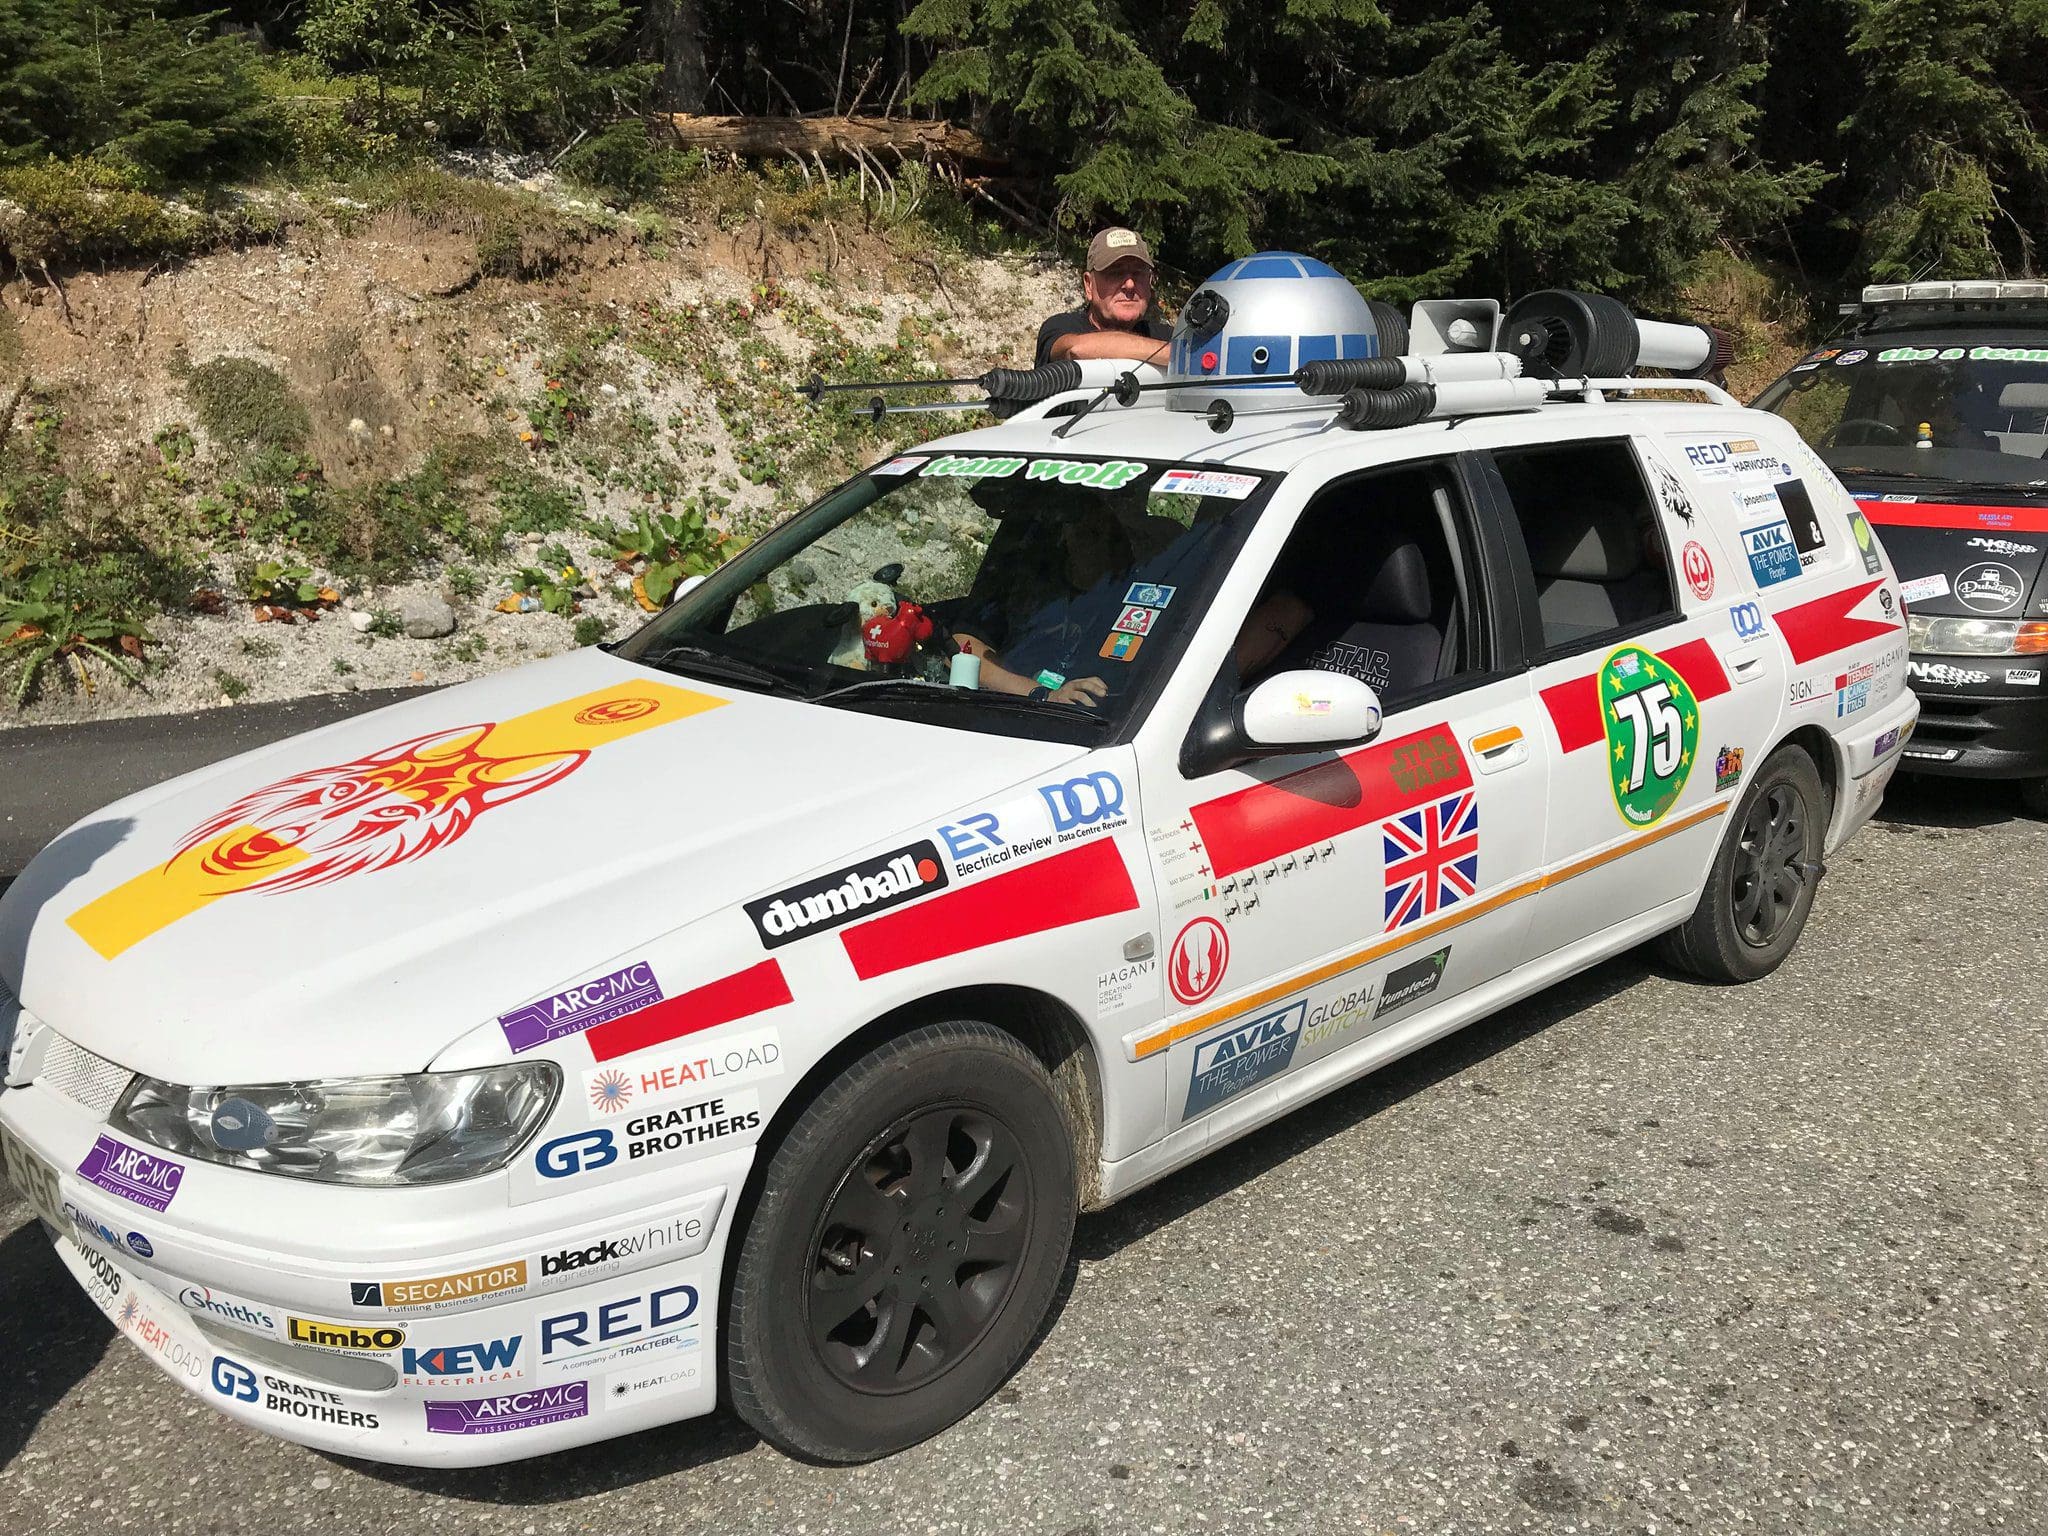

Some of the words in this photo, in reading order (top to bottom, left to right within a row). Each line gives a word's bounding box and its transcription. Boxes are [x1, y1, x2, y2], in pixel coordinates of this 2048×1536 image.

[1878, 347, 1939, 362] the
[1939, 348, 1965, 359] a
[918, 455, 1027, 477] team
[1025, 458, 1148, 489] wolf
[1685, 445, 1726, 466] RED
[1732, 457, 1779, 472] HARWOODS
[1752, 528, 1785, 551] AVK
[1810, 521, 1822, 543] &
[1753, 553, 1770, 570] THE
[1768, 545, 1795, 566] POWER
[1313, 641, 1390, 678] STAR
[1323, 663, 1350, 676] FORCE
[1353, 671, 1390, 688] AWAKENS
[1389, 735, 1455, 773] STAR
[1613, 680, 1682, 793] 75
[1393, 752, 1459, 794] WARS
[1038, 771, 1125, 832] DCR
[937, 812, 1005, 861] ER
[1058, 831, 1076, 843] Data
[1076, 826, 1101, 838] Centre
[1102, 818, 1128, 831] Review
[956, 846, 1011, 877] Electrical
[1013, 836, 1052, 858] Review
[762, 856, 922, 936] dumball
[553, 965, 651, 1019] ARC:MC
[1308, 984, 1375, 1027] GLOBAL
[558, 1015, 606, 1037] MISSION
[609, 994, 661, 1018] CRITICAL
[1301, 1004, 1370, 1049] SWITCH
[1210, 1014, 1288, 1067] AVK
[641, 1043, 779, 1094] HEATLOAD
[1200, 1063, 1231, 1094] THE
[1234, 1037, 1291, 1076] POWER
[1221, 1070, 1258, 1096] People
[626, 1098, 725, 1136] GRATTE
[628, 1111, 761, 1159] BROTHERS
[110, 1148, 182, 1191] ARC:MC
[535, 1128, 618, 1179] GB
[97, 1179, 128, 1198] MISSION
[128, 1192, 165, 1212] CRITICAL
[393, 1267, 518, 1302] SECANTOR
[542, 1260, 620, 1287] engineering
[87, 1276, 114, 1310] group
[189, 1290, 274, 1329] Smith's
[388, 1301, 432, 1313] Fulfilling
[435, 1297, 479, 1309] Business
[482, 1286, 526, 1300] Potential
[542, 1285, 699, 1355] RED
[136, 1314, 202, 1377] HEATLOAD
[292, 1342, 341, 1354] Waterproof
[343, 1350, 392, 1358] protectors
[402, 1335, 523, 1375] KEW
[570, 1356, 607, 1369] company
[608, 1352, 617, 1360] of
[619, 1334, 682, 1358] TRACTEBEL
[211, 1356, 260, 1403] GB
[263, 1375, 344, 1405] GRATTE
[403, 1370, 524, 1386] ELECTRICAL
[633, 1368, 696, 1391] HEATLOAD
[266, 1394, 380, 1429] BROTHERS
[475, 1383, 584, 1418] ARC:MC
[475, 1421, 526, 1434] MISSION
[530, 1411, 585, 1425] CRITICAL
